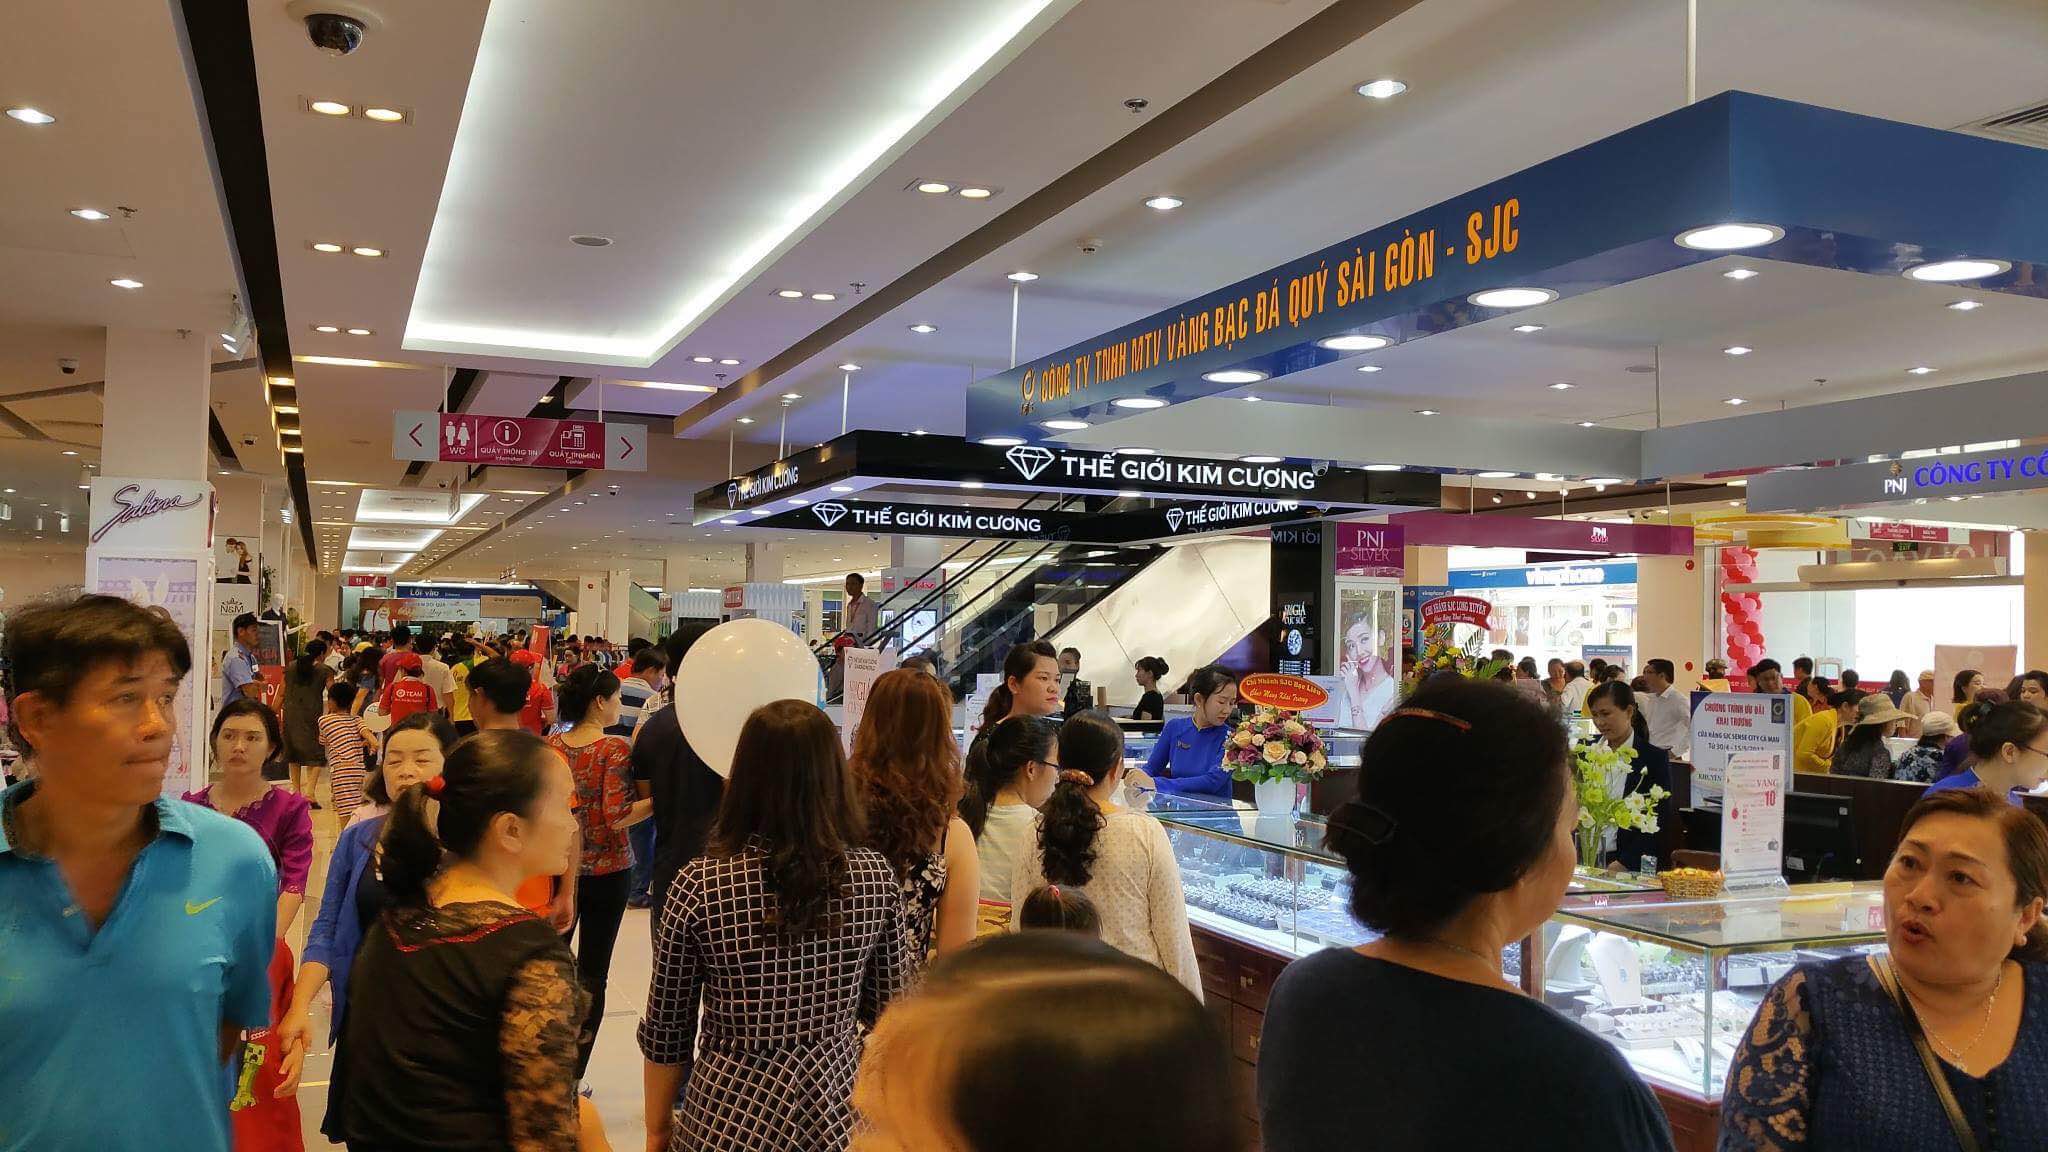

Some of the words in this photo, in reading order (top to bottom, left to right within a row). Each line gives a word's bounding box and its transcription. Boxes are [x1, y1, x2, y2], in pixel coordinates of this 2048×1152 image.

[1041, 362, 1071, 403] CÔNG
[1075, 357, 1090, 392] TY
[1094, 341, 1127, 385] TNHH
[1131, 328, 1162, 373] MTV
[1167, 311, 1209, 362] VÀNG
[1214, 297, 1249, 351] BẠC
[1255, 278, 1280, 333] ĐÁ
[1288, 260, 1329, 328] QUÝ
[1337, 247, 1376, 308] SÀI
[1384, 228, 1435, 292] GÒN
[1446, 246, 1455, 257] -
[1465, 198, 1520, 265] SJC
[449, 446, 466, 456] WC
[503, 447, 527, 457] THÔNG
[528, 449, 538, 457] TIN
[1061, 451, 1115, 479] THẾ
[1120, 458, 1170, 482] GIỚI
[1177, 463, 1222, 485] KIM
[1228, 467, 1316, 490] CƯƠNG
[1884, 477, 1908, 495] PNJ
[1913, 461, 1983, 487] CÔNG
[1986, 458, 2015, 480] TY
[762, 475, 774, 495] KIM
[91, 483, 203, 543] Sabina
[852, 505, 893, 525] THẾ
[896, 509, 934, 528] GIỚI
[938, 514, 972, 529] KIM
[976, 516, 1041, 532] CƯƠNG
[1185, 503, 1207, 525] THẾ
[1208, 502, 1230, 522] GIỚI
[1231, 502, 1252, 519] KIM
[1356, 530, 1385, 551] PNJ
[1350, 548, 1390, 562] SILVER
[1257, 677, 1279, 685] Nhánh
[1279, 678, 1293, 686] SJC
[1716, 716, 1729, 726] KHAI
[1731, 733, 1747, 741] SENSE
